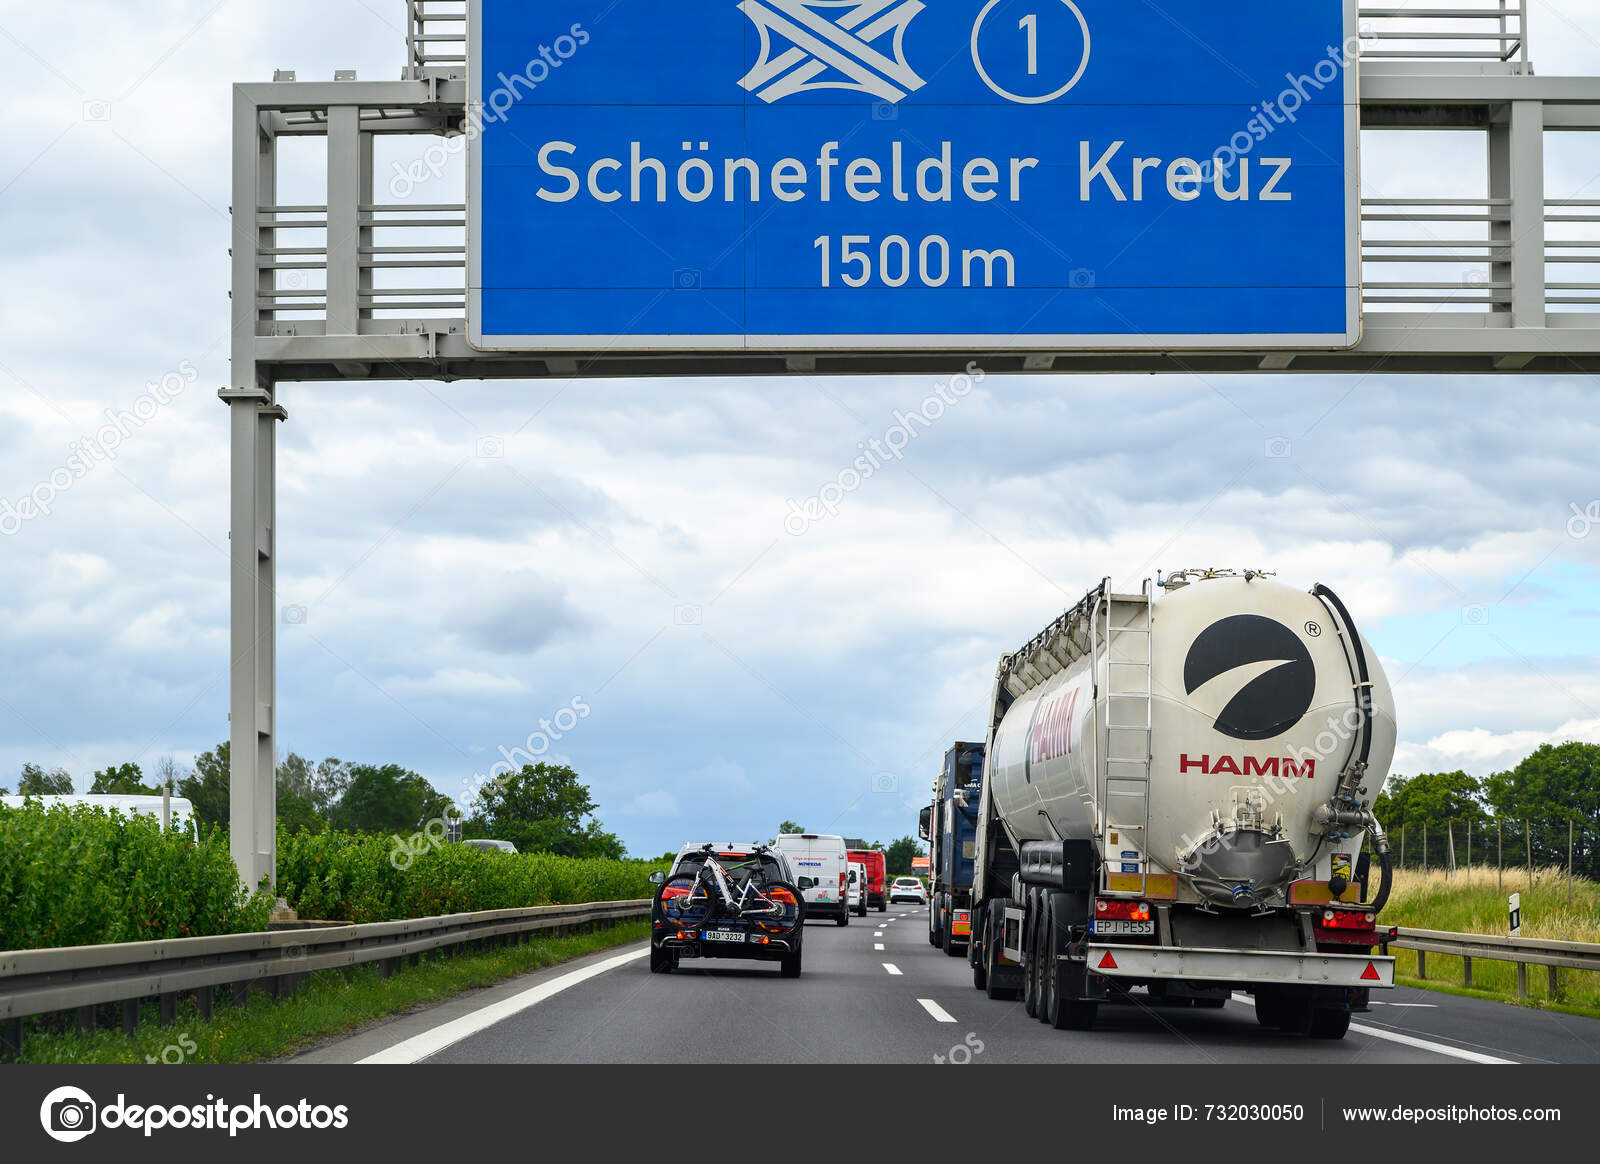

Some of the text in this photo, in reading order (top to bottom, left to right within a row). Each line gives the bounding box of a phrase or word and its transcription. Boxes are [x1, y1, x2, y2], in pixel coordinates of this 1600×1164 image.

[1020, 15, 1037, 75] 1
[536, 141, 1292, 203] Schönefelder Kreuz
[814, 234, 1016, 288] 1500m
[1180, 753, 1316, 779] HAMM
